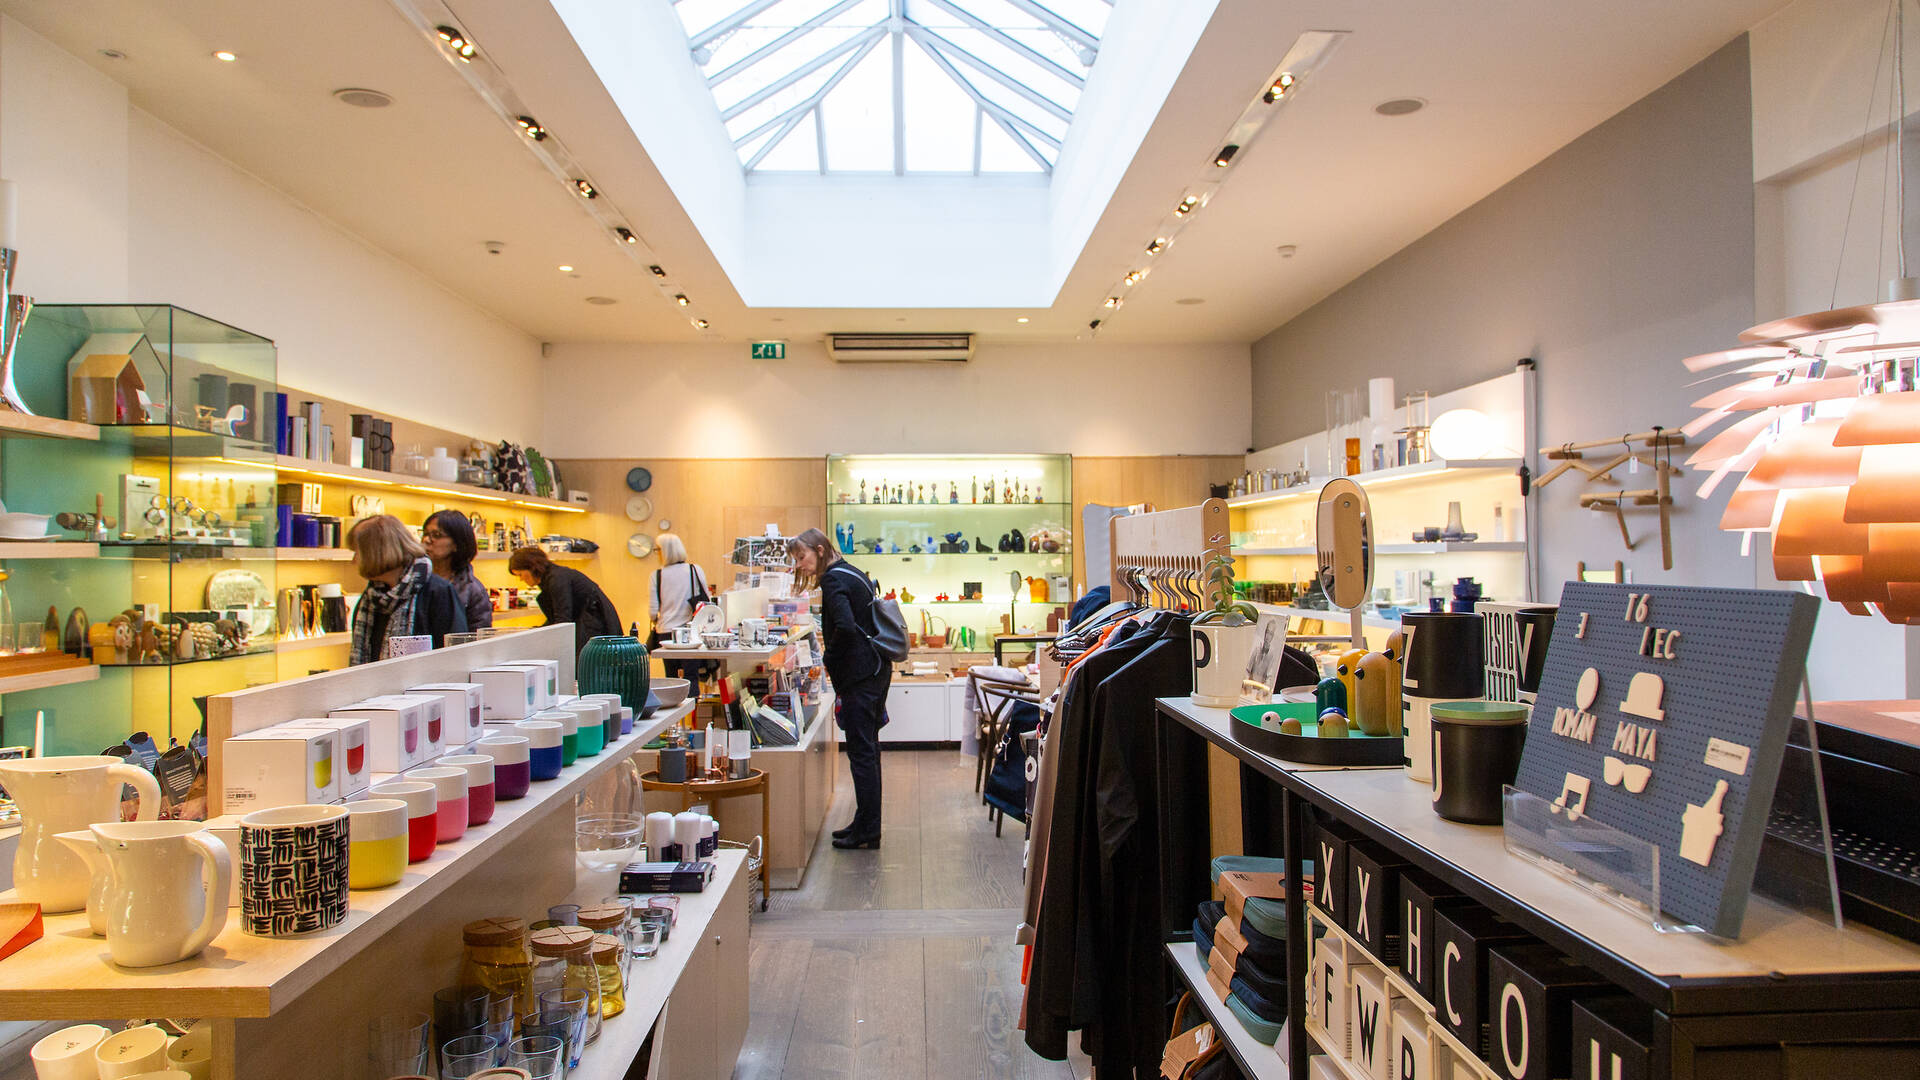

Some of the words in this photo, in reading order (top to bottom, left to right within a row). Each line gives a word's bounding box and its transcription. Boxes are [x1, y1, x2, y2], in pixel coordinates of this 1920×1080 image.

[1193, 630, 1211, 694] P
[1515, 621, 1534, 684] V
[1613, 721, 1657, 762] MAYA
[1321, 841, 1334, 912] X
[1357, 866, 1370, 942] X
[1408, 899, 1421, 984] H
[1324, 962, 1334, 1030] F
[1444, 941, 1461, 1026] C
[1356, 984, 1379, 1071] W
[1501, 982, 1529, 1080] O
